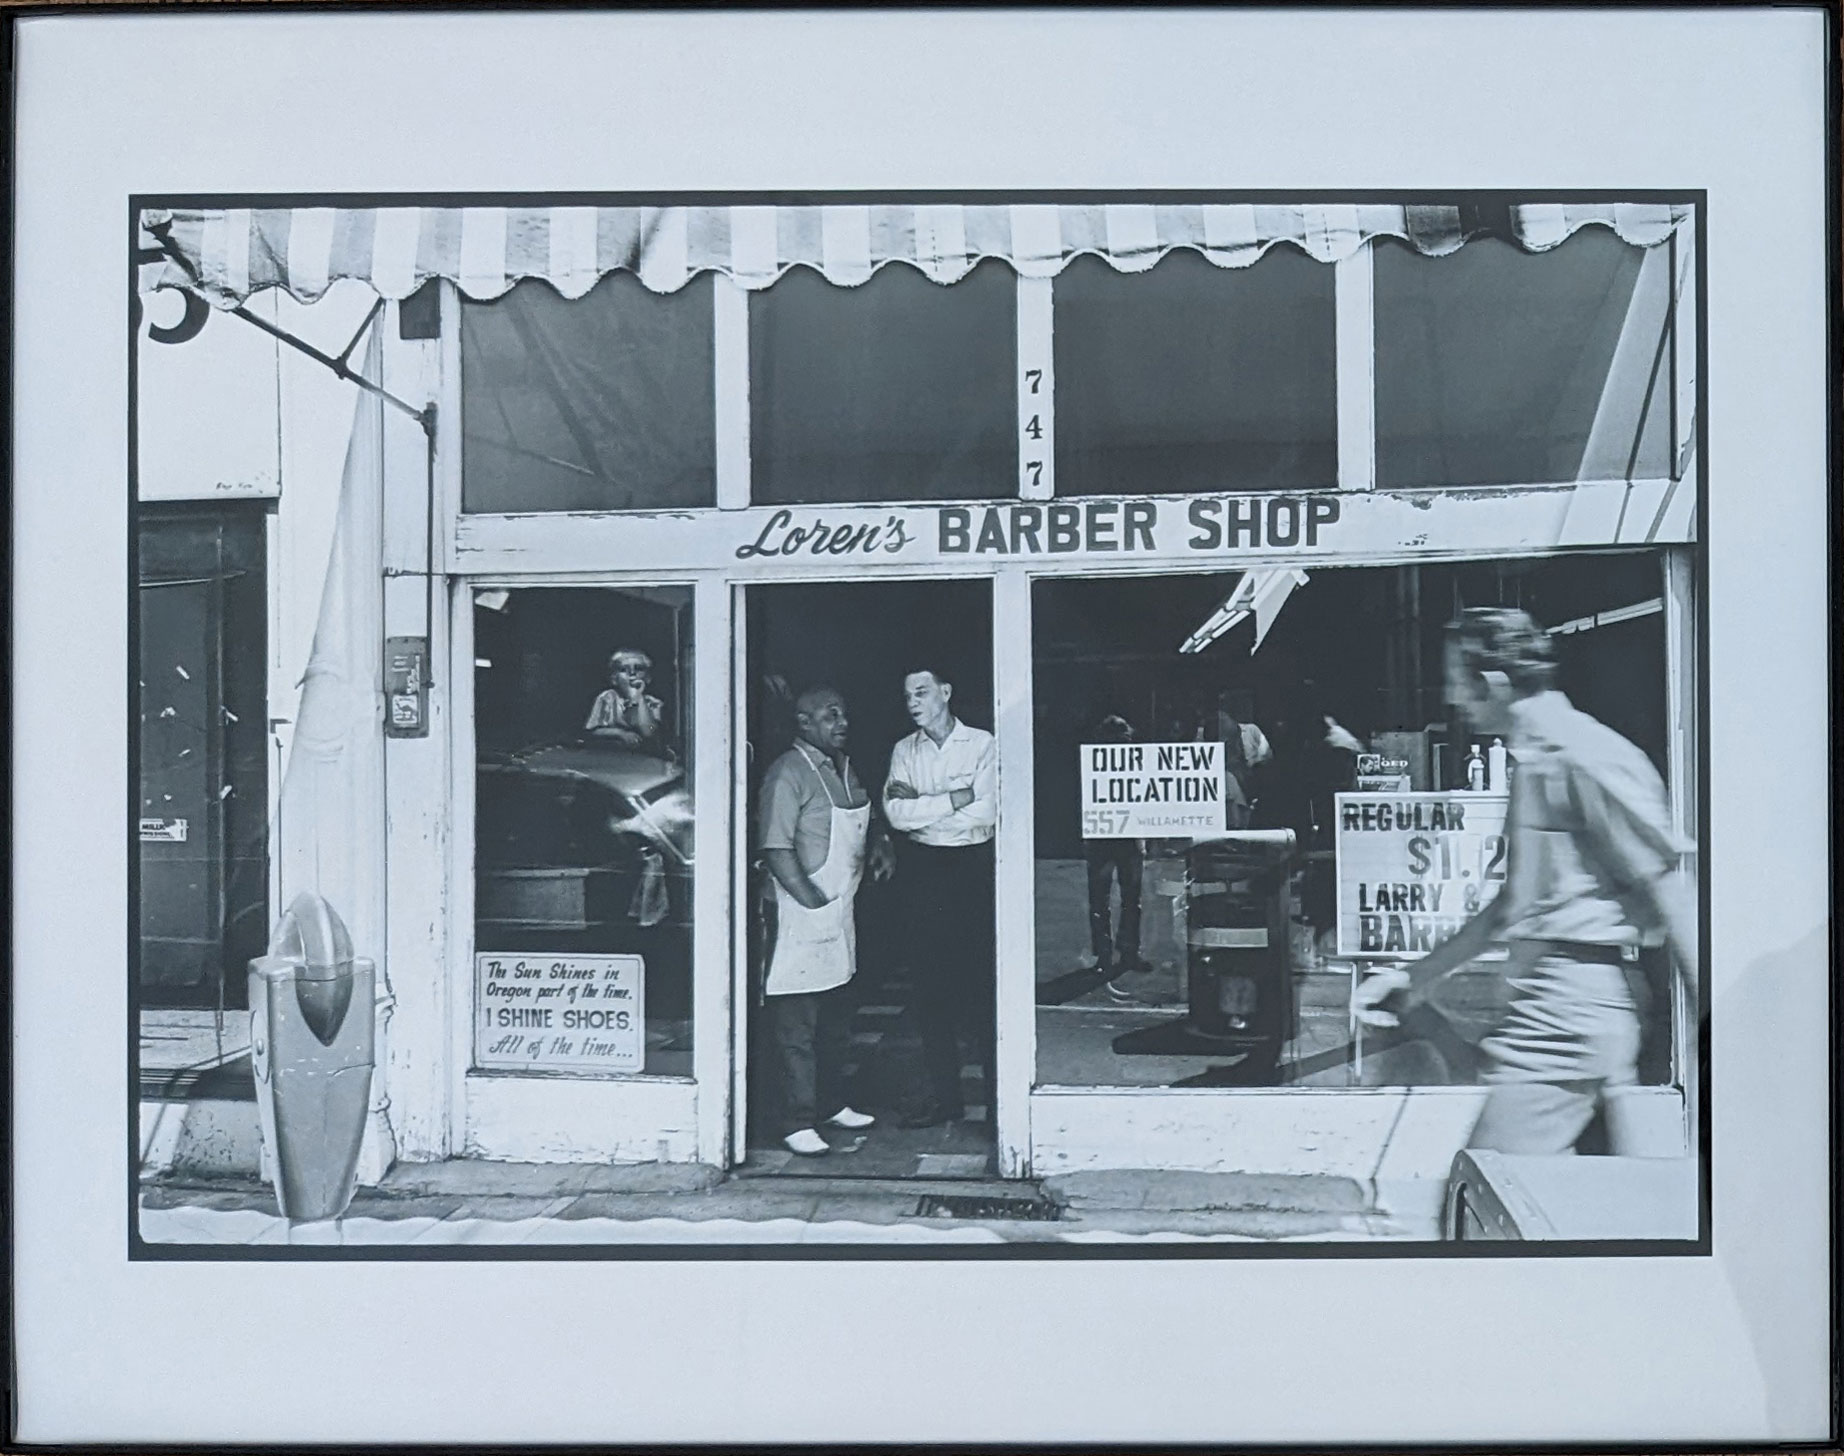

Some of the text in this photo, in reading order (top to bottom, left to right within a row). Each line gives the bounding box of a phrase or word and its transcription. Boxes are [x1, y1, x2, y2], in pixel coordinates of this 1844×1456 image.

[736, 498, 1340, 559] Loren's BARBER SHOP
[1092, 746, 1214, 772] OUR NEW
[1092, 777, 1218, 803] LOCATION
[1084, 810, 1130, 834] 557
[1343, 803, 1465, 831] REGULAR
[1359, 883, 1443, 912] LARRY
[487, 961, 620, 980] The Sun Shines in
[486, 982, 632, 1004] Oregon part of the time.
[486, 1008, 633, 1031] I SHINE SHOES.
[489, 1035, 524, 1054] All
[527, 1036, 544, 1060] of
[549, 1036, 573, 1055] the
